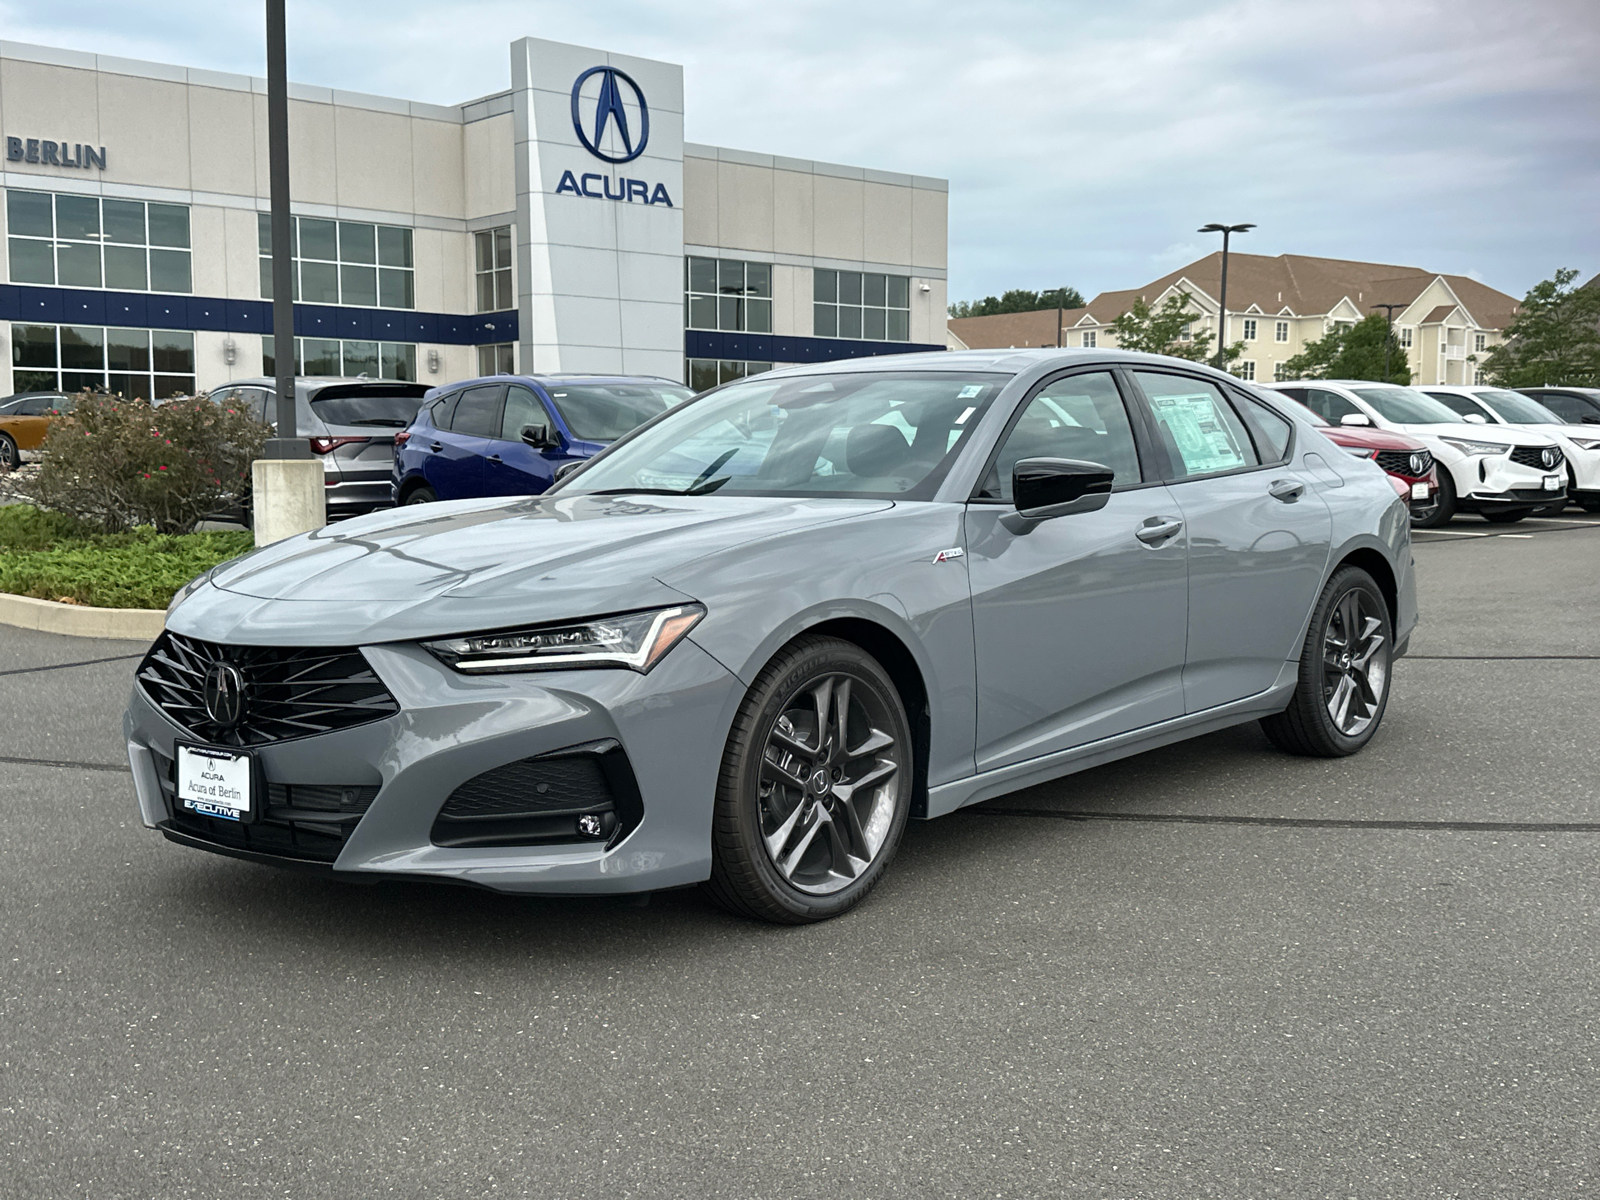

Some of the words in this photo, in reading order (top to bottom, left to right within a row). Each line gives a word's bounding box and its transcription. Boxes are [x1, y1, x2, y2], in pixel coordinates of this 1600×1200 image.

[7, 136, 106, 170] BERLIN
[555, 170, 673, 207] ACURA
[779, 655, 828, 694] MICHELIN
[188, 780, 208, 795] Acura
[208, 785, 217, 796] of
[218, 785, 242, 801] Berlin
[201, 772, 225, 782] ACURA
[184, 799, 240, 818] EXECUTIVE
